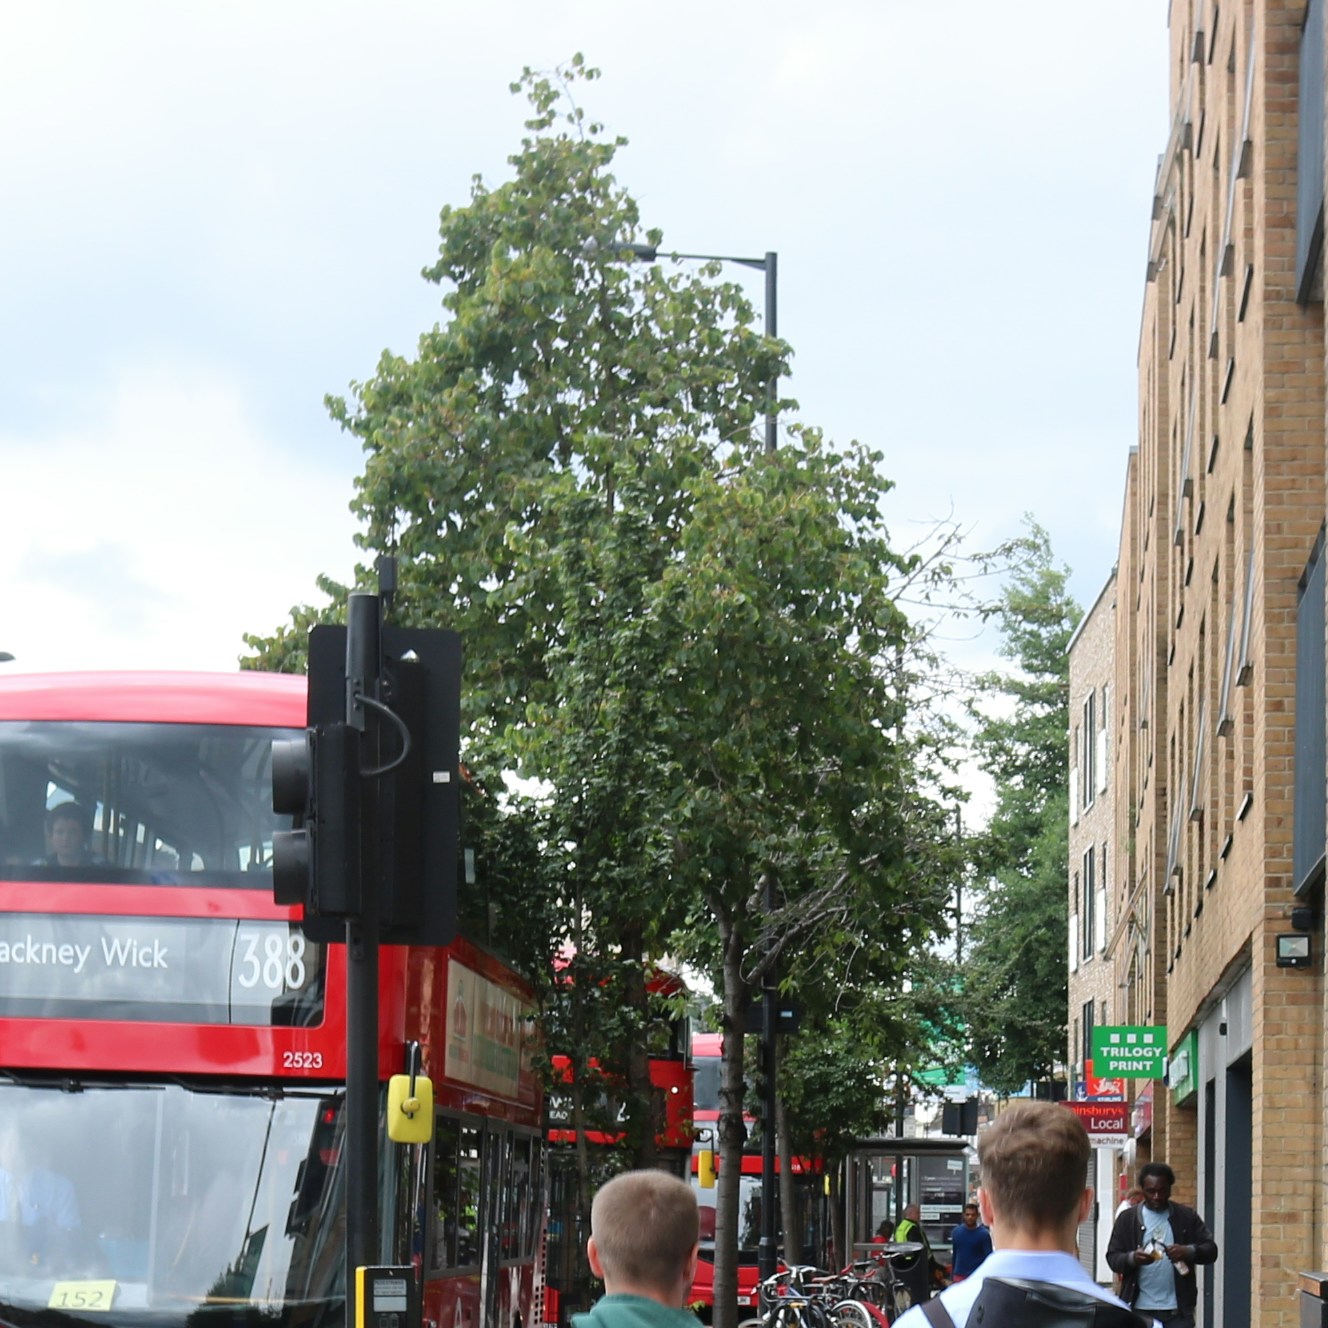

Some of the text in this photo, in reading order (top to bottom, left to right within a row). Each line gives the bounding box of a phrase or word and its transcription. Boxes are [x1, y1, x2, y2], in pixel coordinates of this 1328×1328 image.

[100, 937, 168, 969] Wick
[238, 932, 306, 990] 388
[1100, 1046, 1163, 1058] TRILOGY
[283, 1052, 323, 1069] 2523
[1109, 1061, 1154, 1071] PRINT
[1090, 1117, 1124, 1130] Local
[57, 1291, 104, 1308] 152
